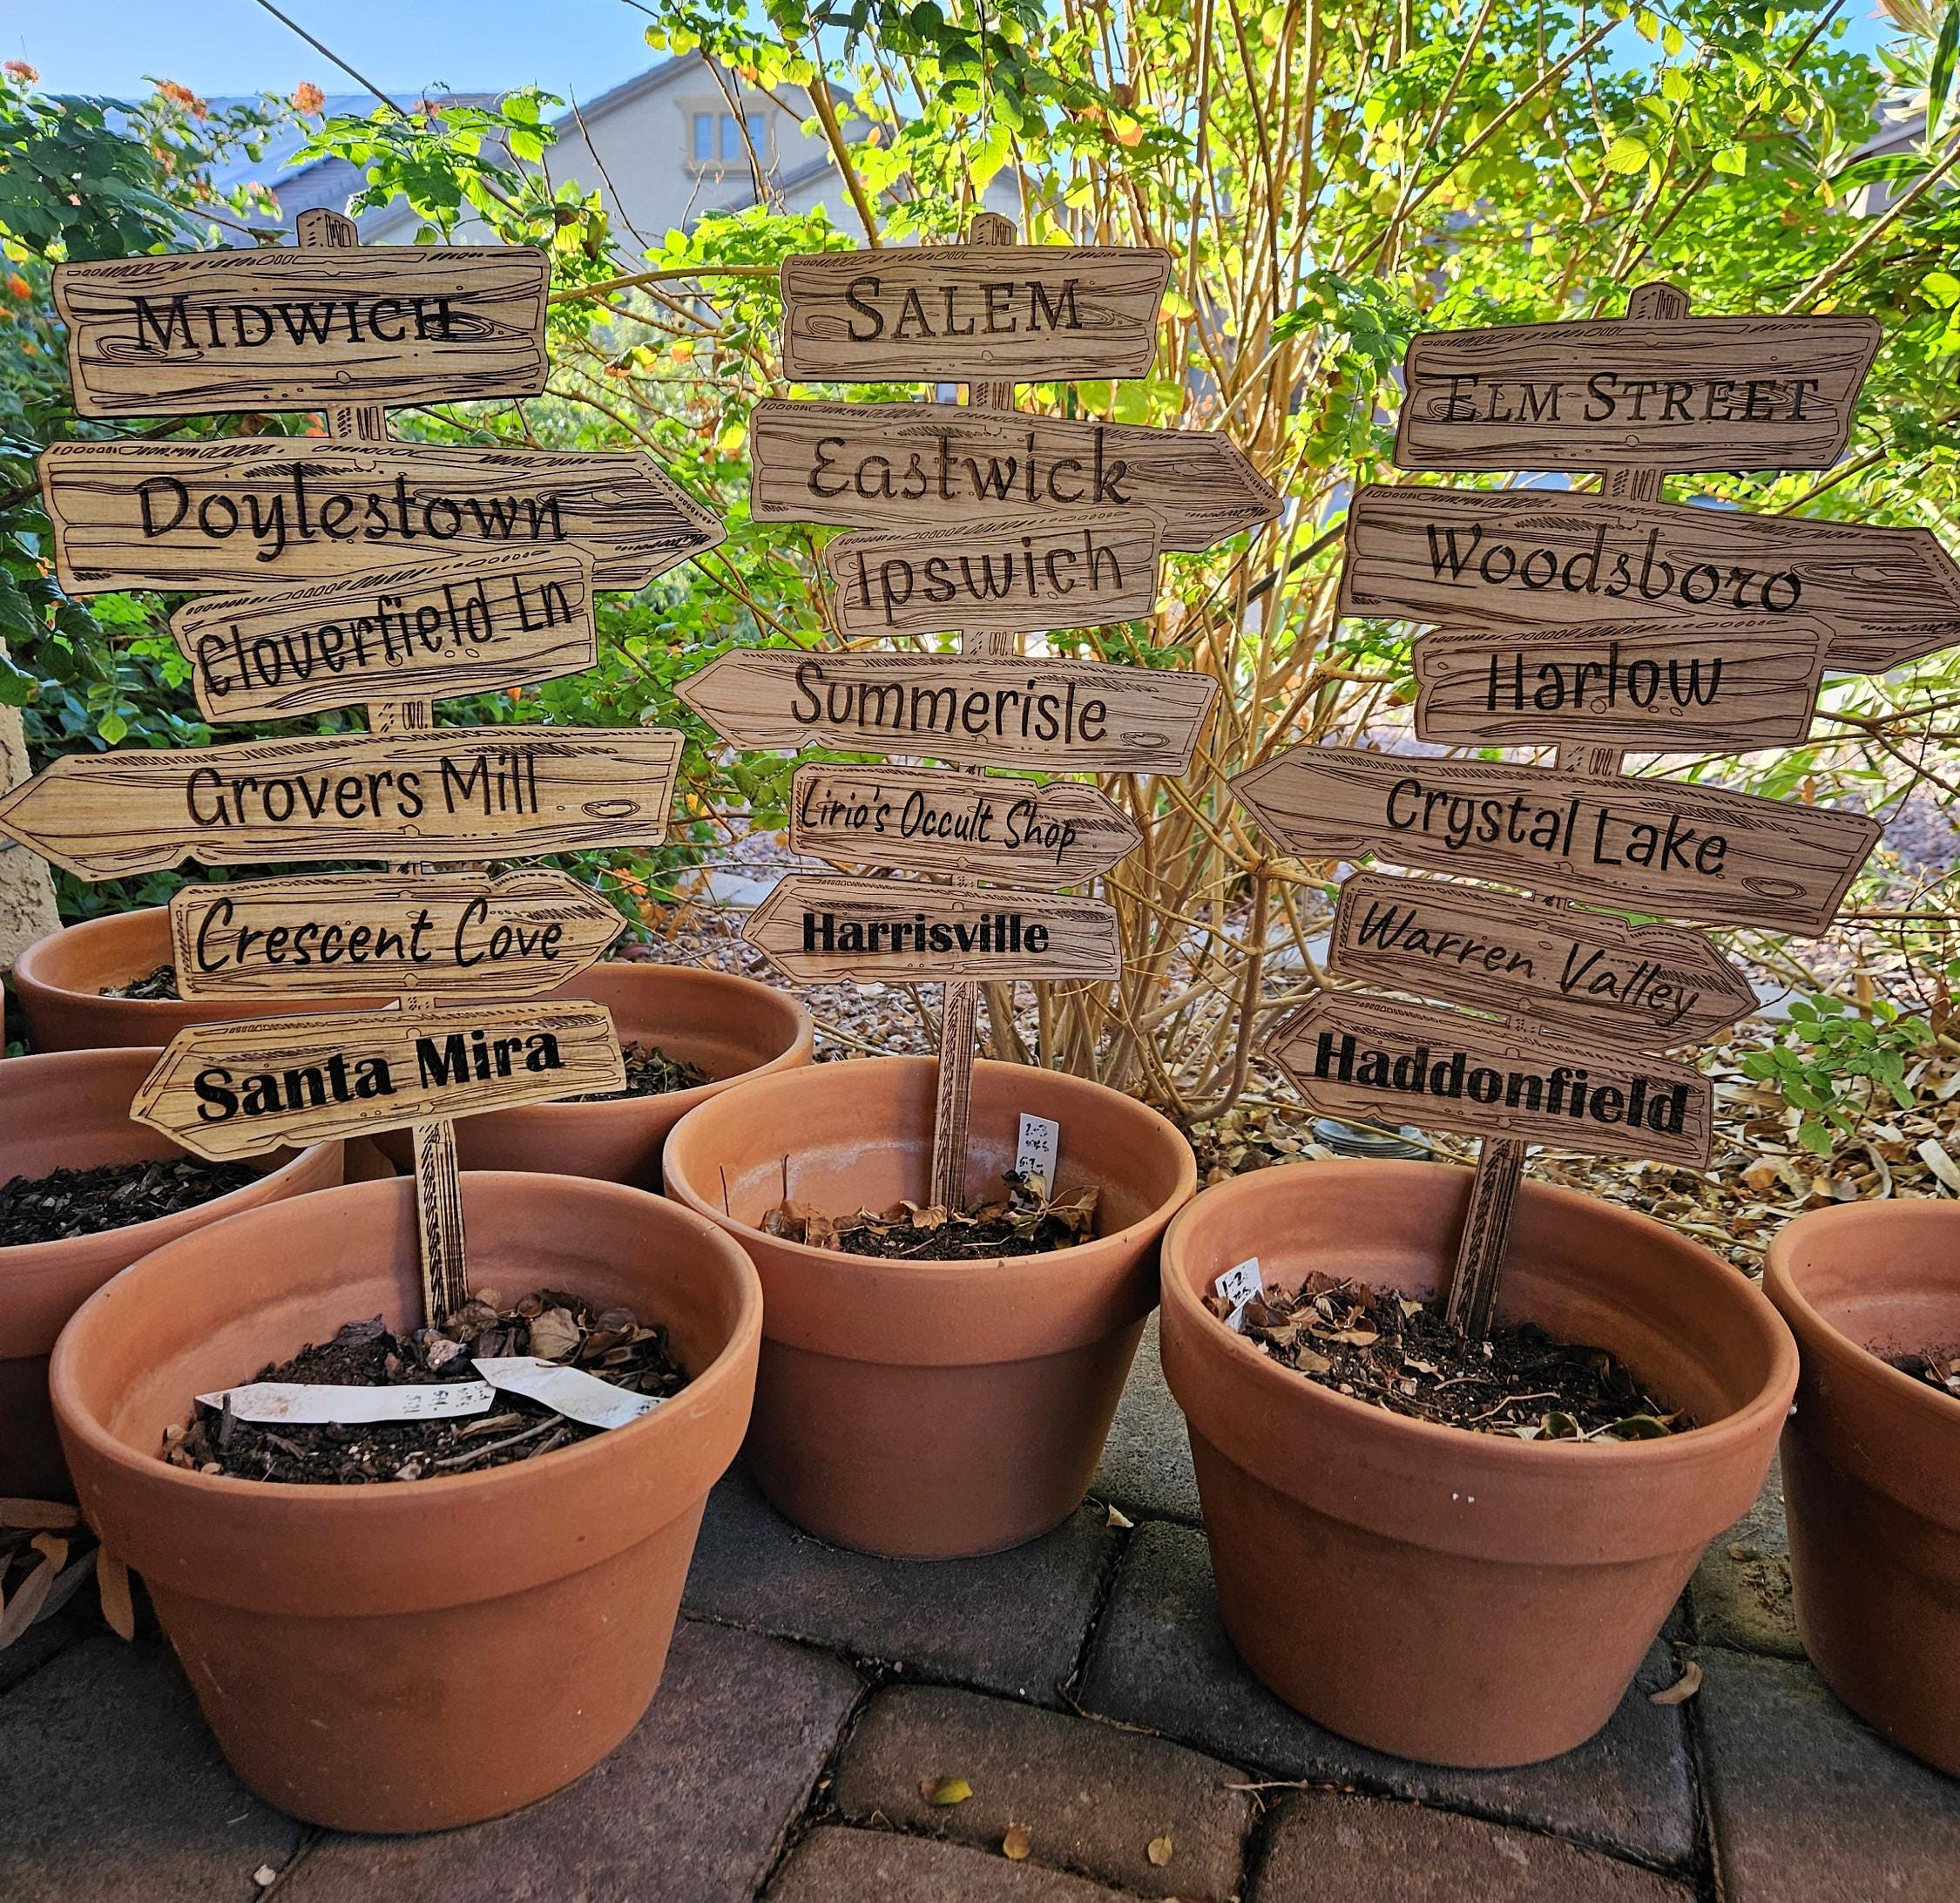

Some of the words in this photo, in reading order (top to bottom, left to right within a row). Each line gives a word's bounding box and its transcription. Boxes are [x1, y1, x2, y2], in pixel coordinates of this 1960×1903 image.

[128, 294, 460, 350] MIDWICH
[845, 276, 1083, 342] SALEM
[1441, 373, 1564, 423] ELM
[1584, 372, 1819, 423] STREET
[808, 427, 1132, 505] Eastwick
[139, 464, 567, 562] Doylestown
[855, 529, 1122, 626] Ipswich
[1426, 522, 1802, 613] Woodsboro
[196, 576, 493, 697] Cloverfield
[517, 575, 571, 633] Ln
[1487, 642, 1722, 712] Harlow
[791, 660, 1107, 742] Summerisle
[186, 768, 424, 825] Grovers
[441, 753, 539, 815] Mill
[801, 777, 889, 834] Lirio's
[901, 790, 993, 843] Occult
[1004, 800, 1078, 864] Shop
[1386, 778, 1578, 857] Crystal
[1593, 809, 1728, 876] Lake
[197, 897, 433, 972] Crescent
[455, 897, 563, 968] Cove
[803, 912, 1050, 954] Harrisville
[1356, 901, 1536, 979] Warren
[1559, 942, 1700, 1026] Valley
[193, 1053, 396, 1122] Santa
[416, 1029, 564, 1089] Mira
[1314, 1031, 1688, 1134] Haddonfield
